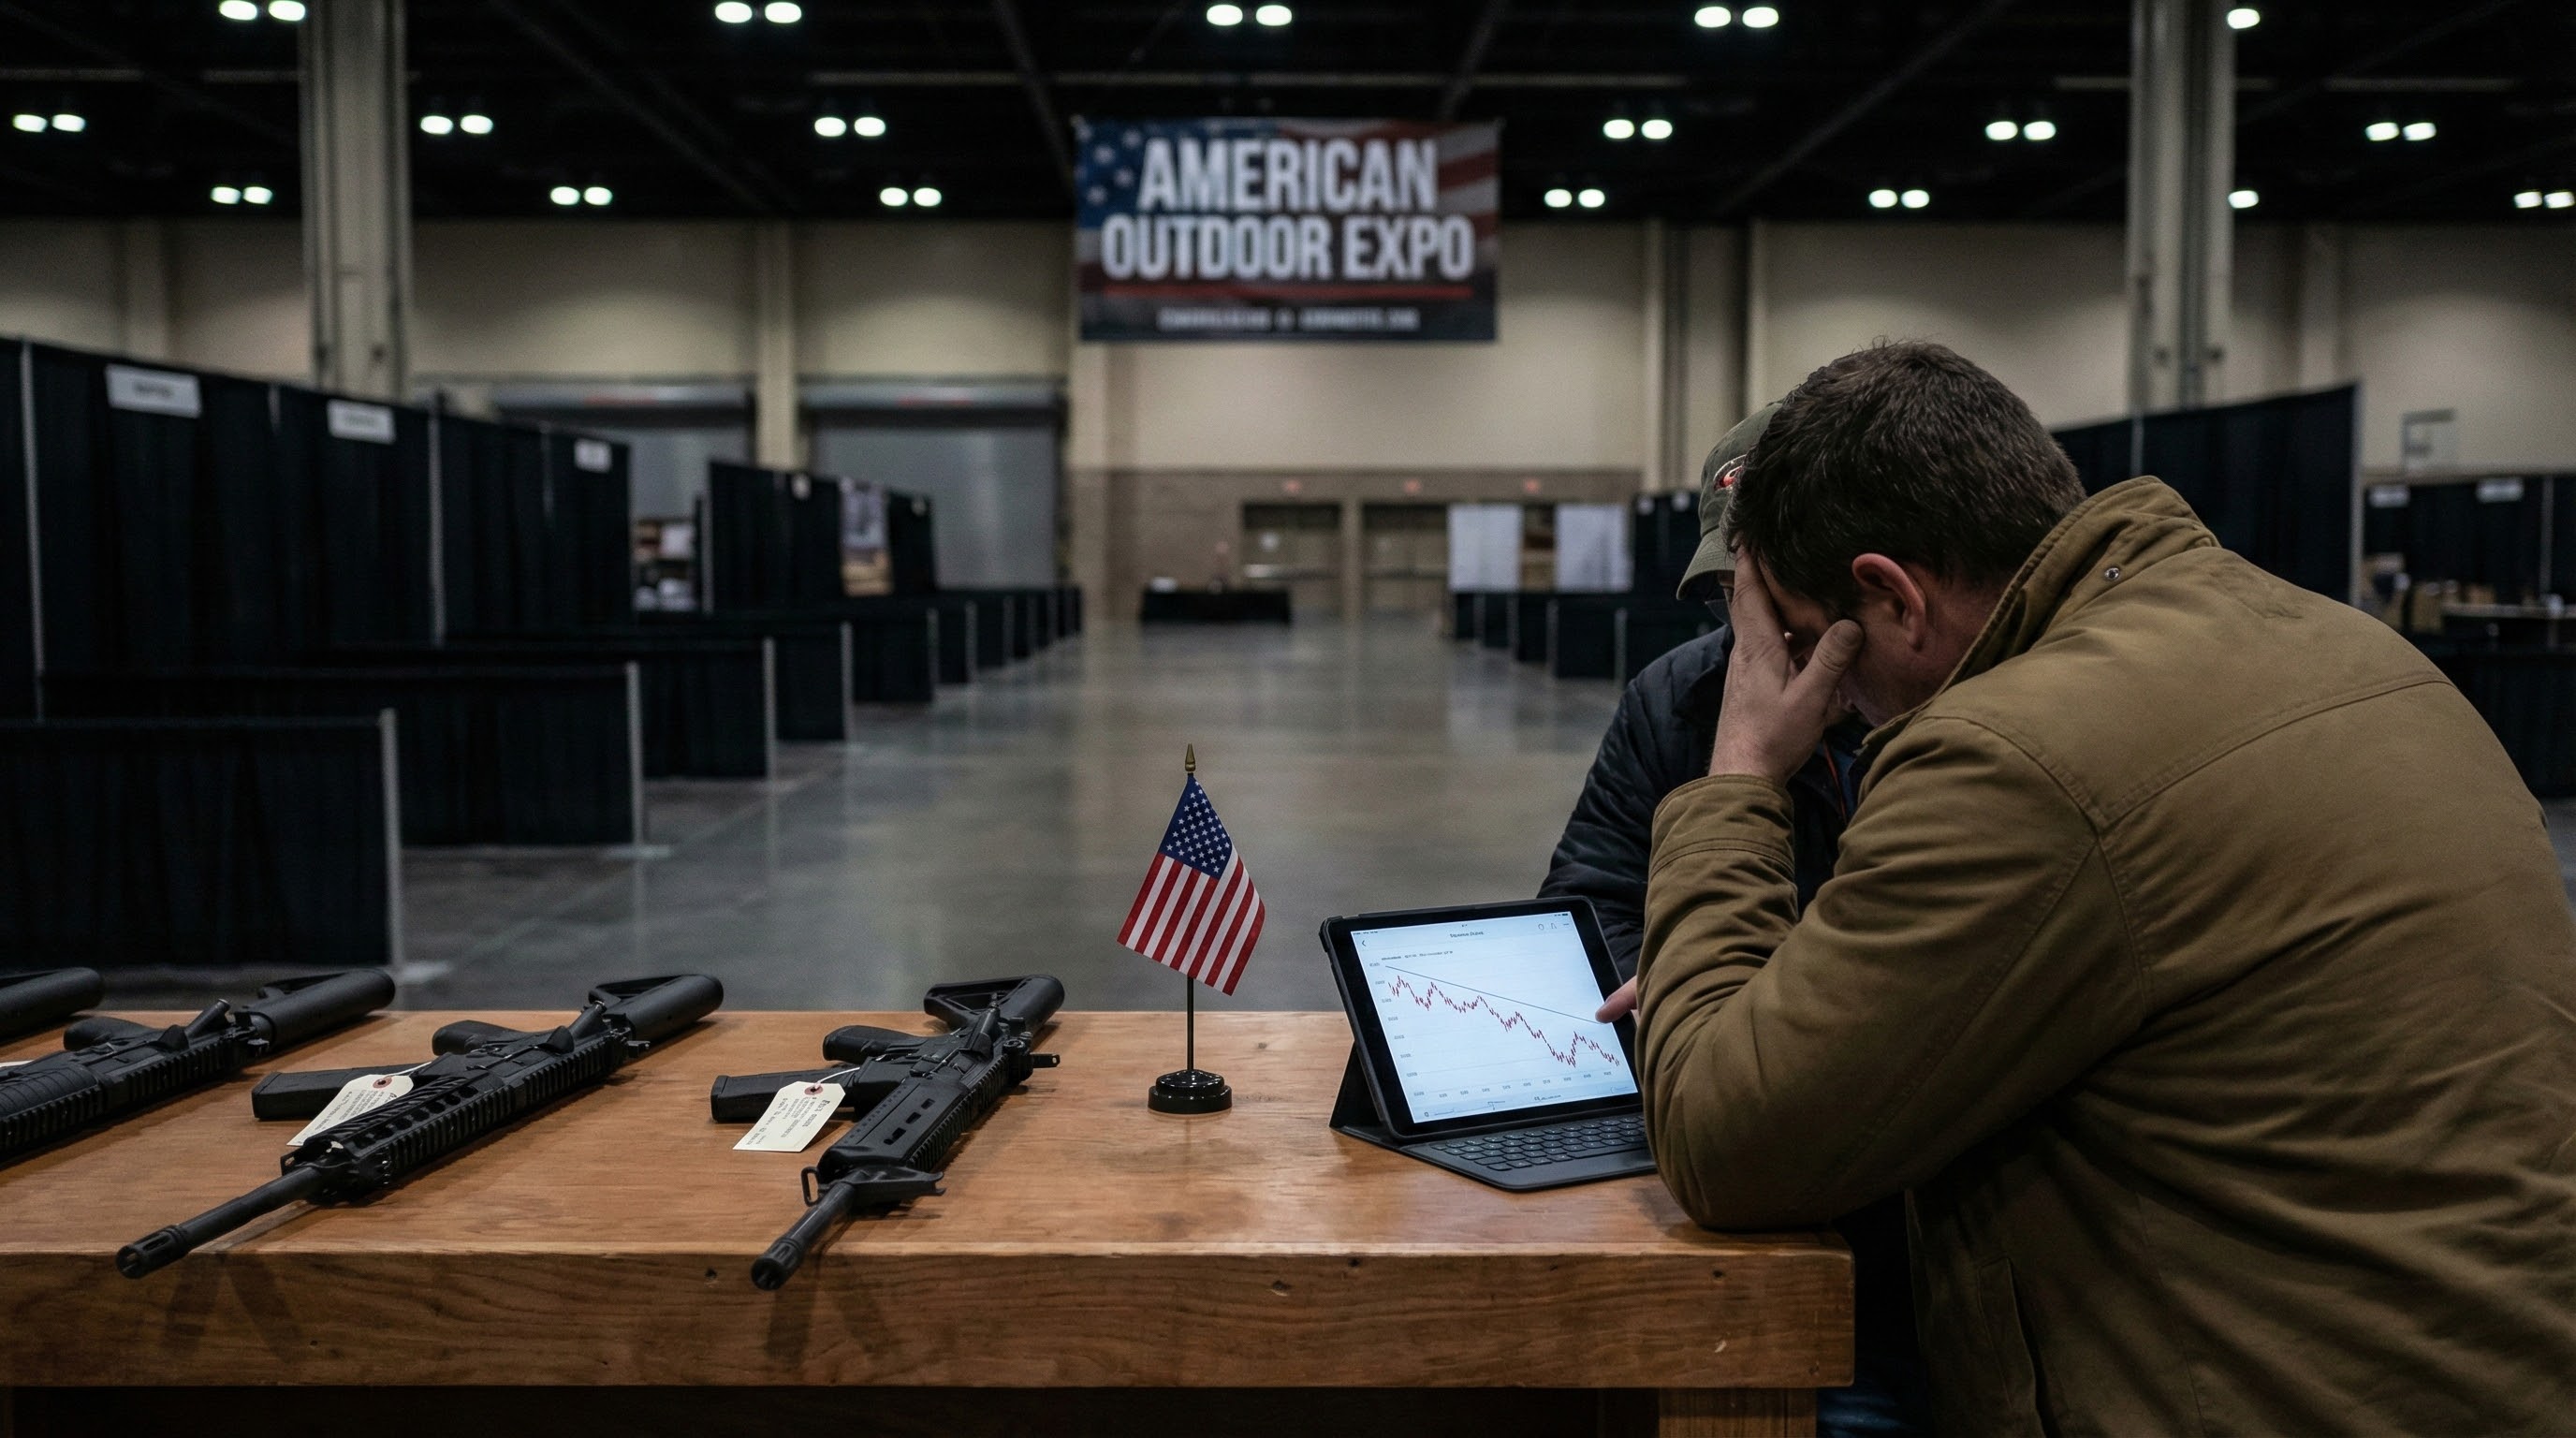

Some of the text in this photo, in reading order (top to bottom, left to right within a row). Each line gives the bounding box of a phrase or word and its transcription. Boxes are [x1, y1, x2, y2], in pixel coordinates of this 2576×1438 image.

[1137, 137, 1439, 212] AMERICAN
[1101, 213, 1476, 280] OUTDOOR EXPO
